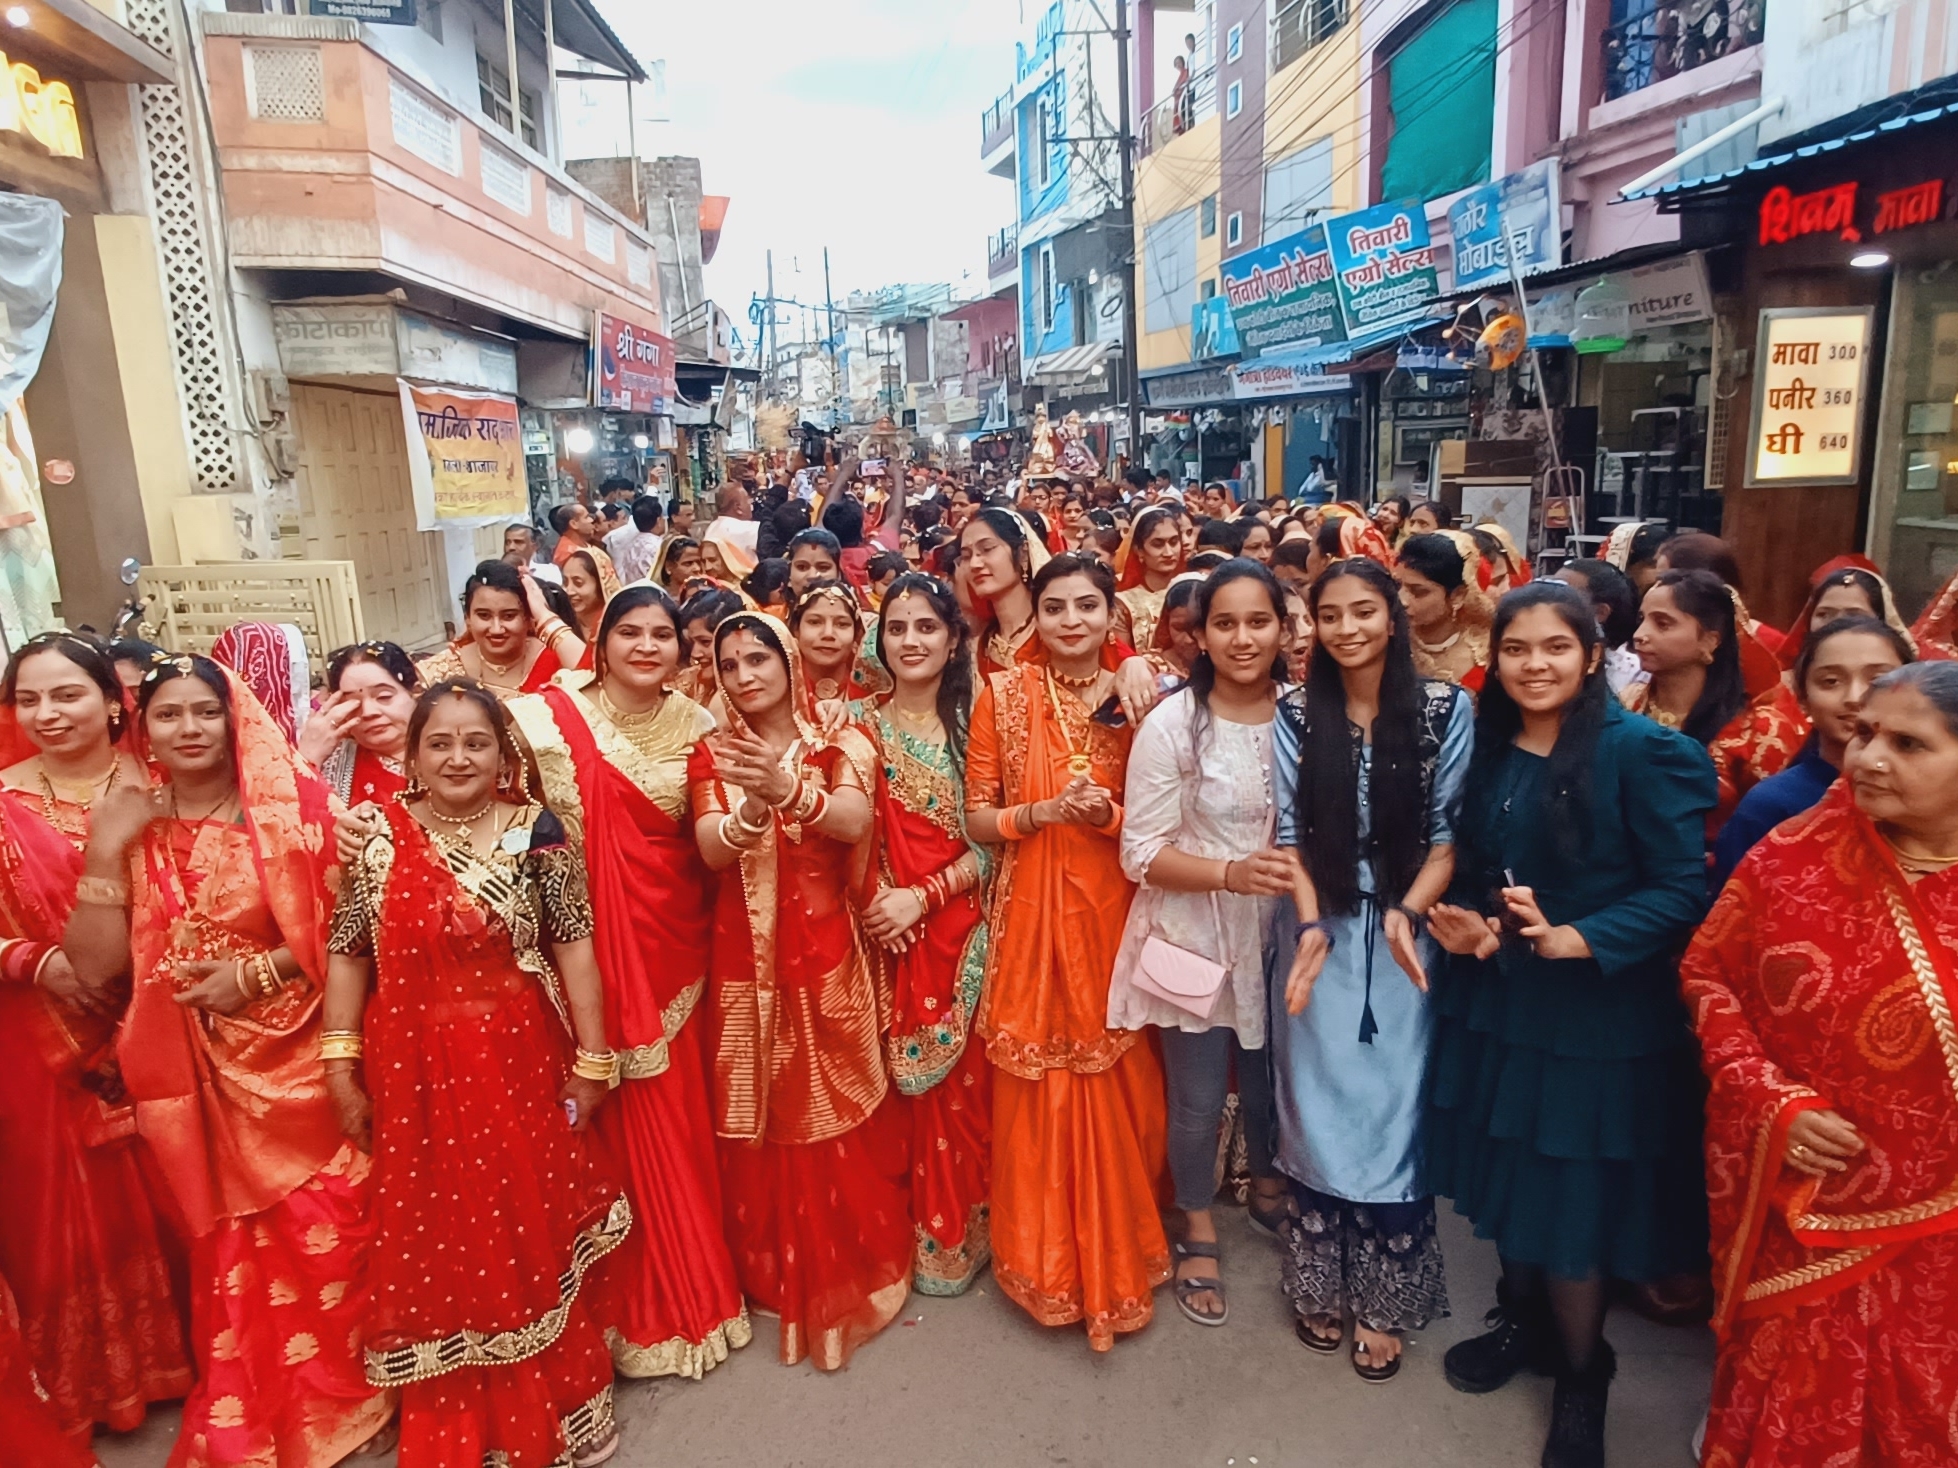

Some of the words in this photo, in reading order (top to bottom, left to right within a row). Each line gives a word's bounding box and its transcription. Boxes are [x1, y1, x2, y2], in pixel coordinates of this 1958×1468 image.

[1759, 181, 1861, 246] शिवम्
[1873, 178, 1944, 234] मावा
[1350, 216, 1410, 255] तिवारी
[1226, 266, 1267, 308] तिवारी
[1266, 255, 1295, 301] एग्रो
[1295, 249, 1332, 286] सेल्स
[1344, 257, 1382, 292] एग्रो
[1386, 251, 1436, 276] सेल्स
[616, 324, 635, 361] श्री
[636, 330, 659, 367] गंगा
[1772, 342, 1821, 365] मावा
[1828, 345, 1857, 360] 300
[1769, 377, 1818, 410] पनीर
[1824, 390, 1852, 405] 360
[1765, 422, 1805, 455] घी
[1819, 435, 1848, 449] 640
